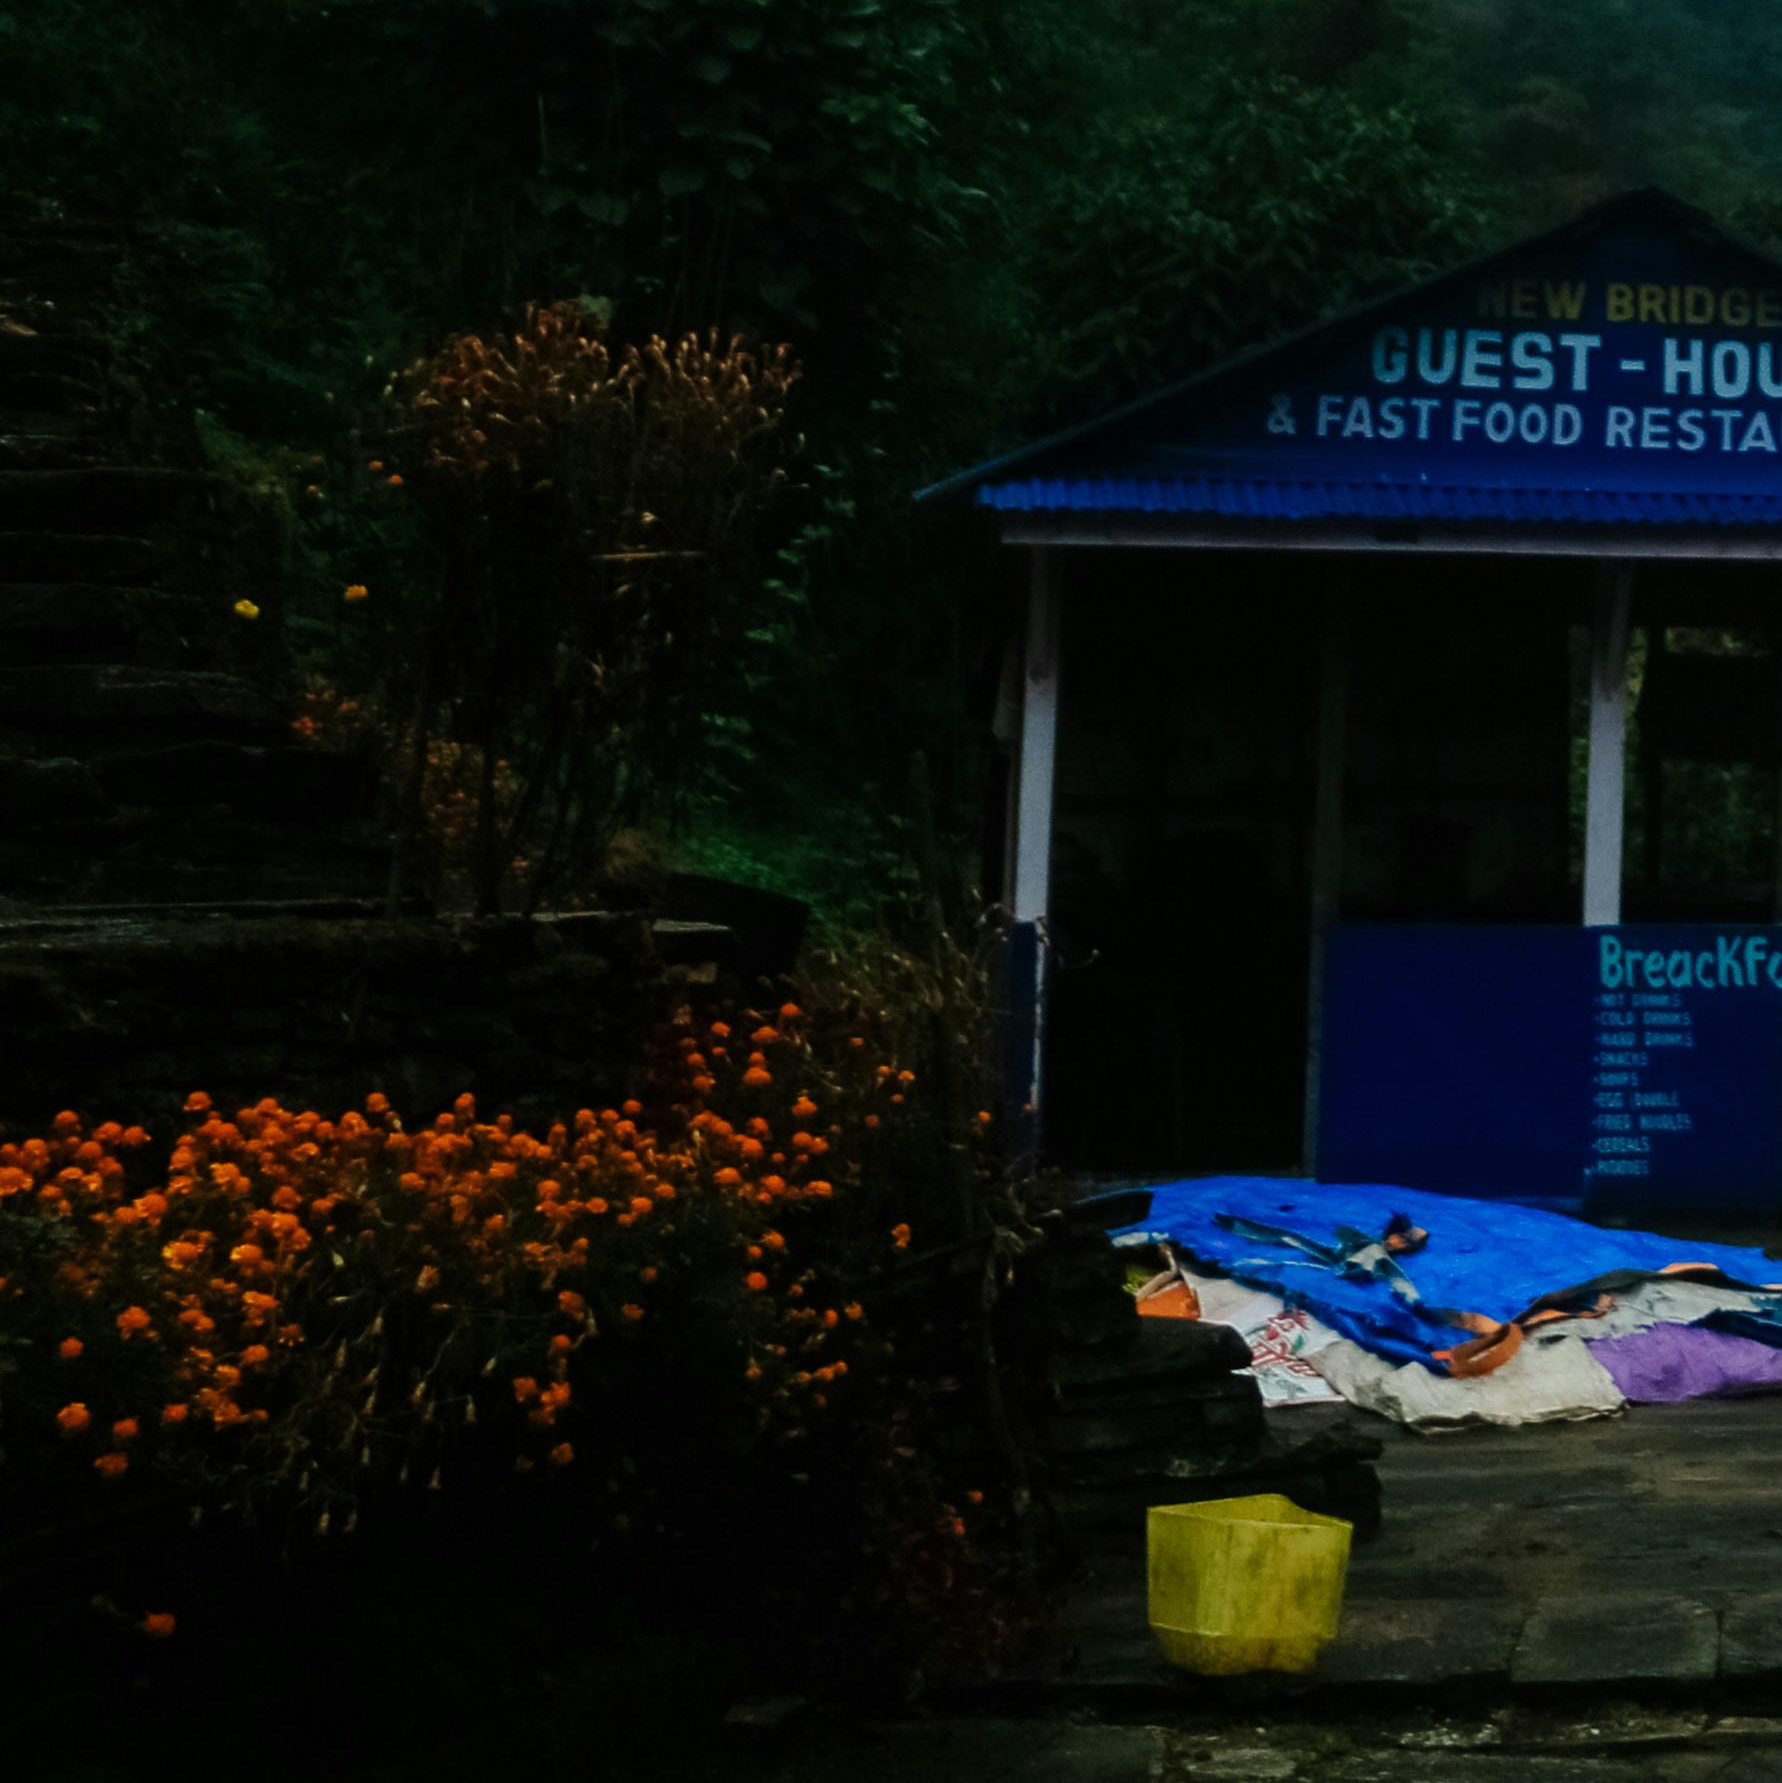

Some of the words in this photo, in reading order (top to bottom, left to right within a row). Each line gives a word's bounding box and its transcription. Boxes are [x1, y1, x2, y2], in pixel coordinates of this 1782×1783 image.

[1477, 280, 1587, 322] NEW
[1373, 326, 1601, 391] GUEST
[1265, 397, 1298, 437] &
[1317, 394, 1439, 441] FAST
[1453, 399, 1583, 447] FOOD
